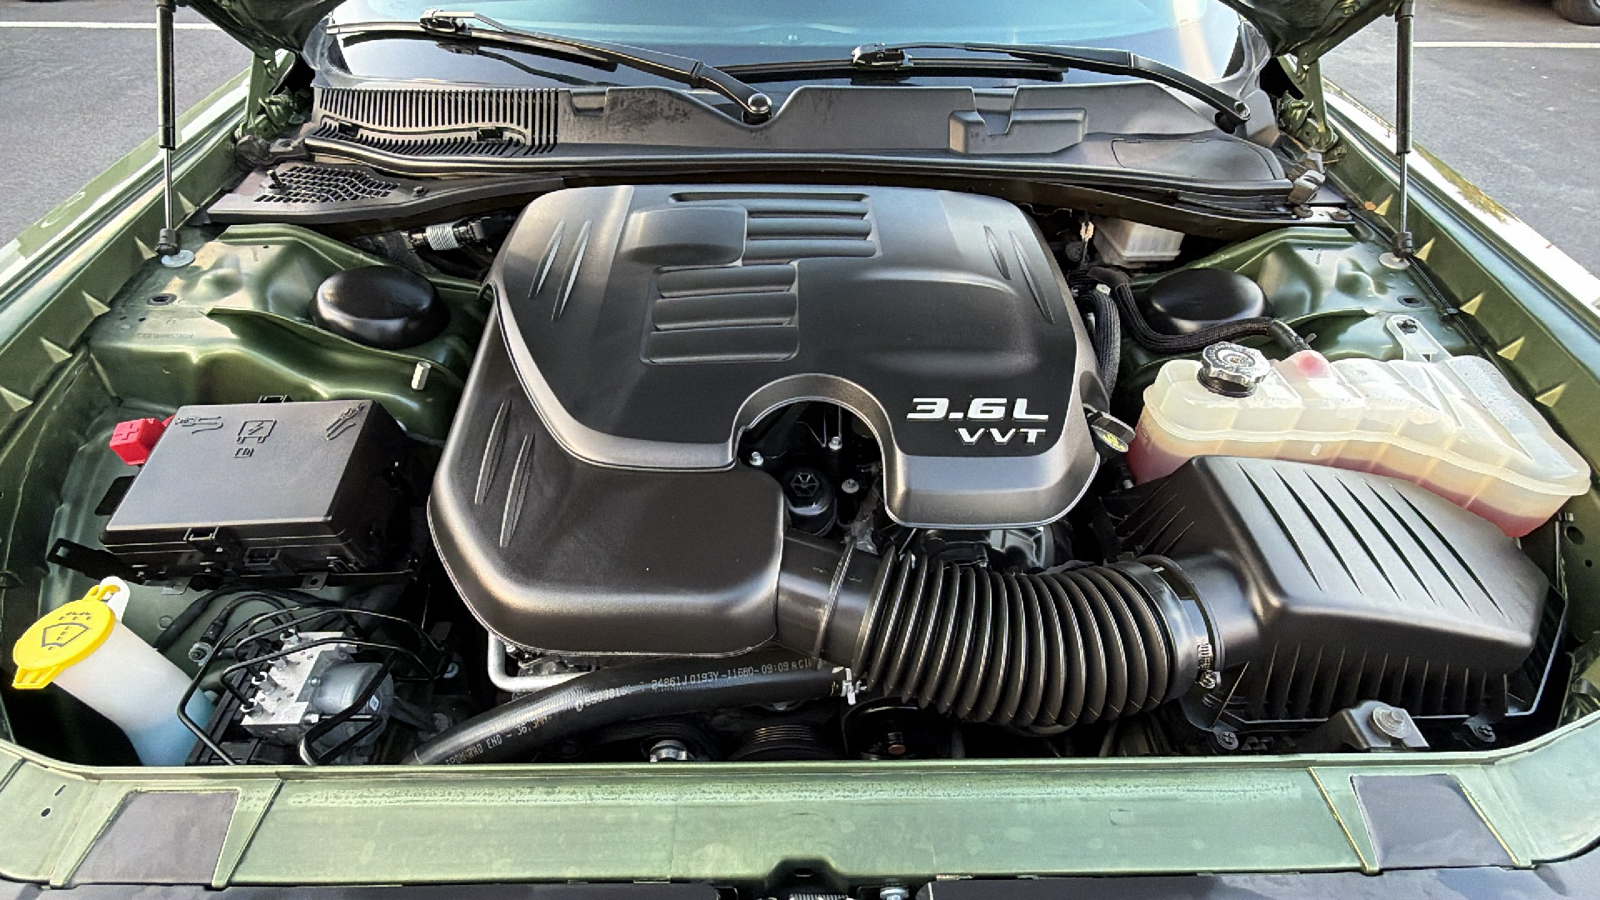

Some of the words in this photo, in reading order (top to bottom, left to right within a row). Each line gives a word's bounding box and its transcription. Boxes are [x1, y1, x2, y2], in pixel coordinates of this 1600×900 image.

[906, 397, 1049, 422] 3.6L
[956, 427, 1047, 446] VVT
[486, 735, 503, 749] END
